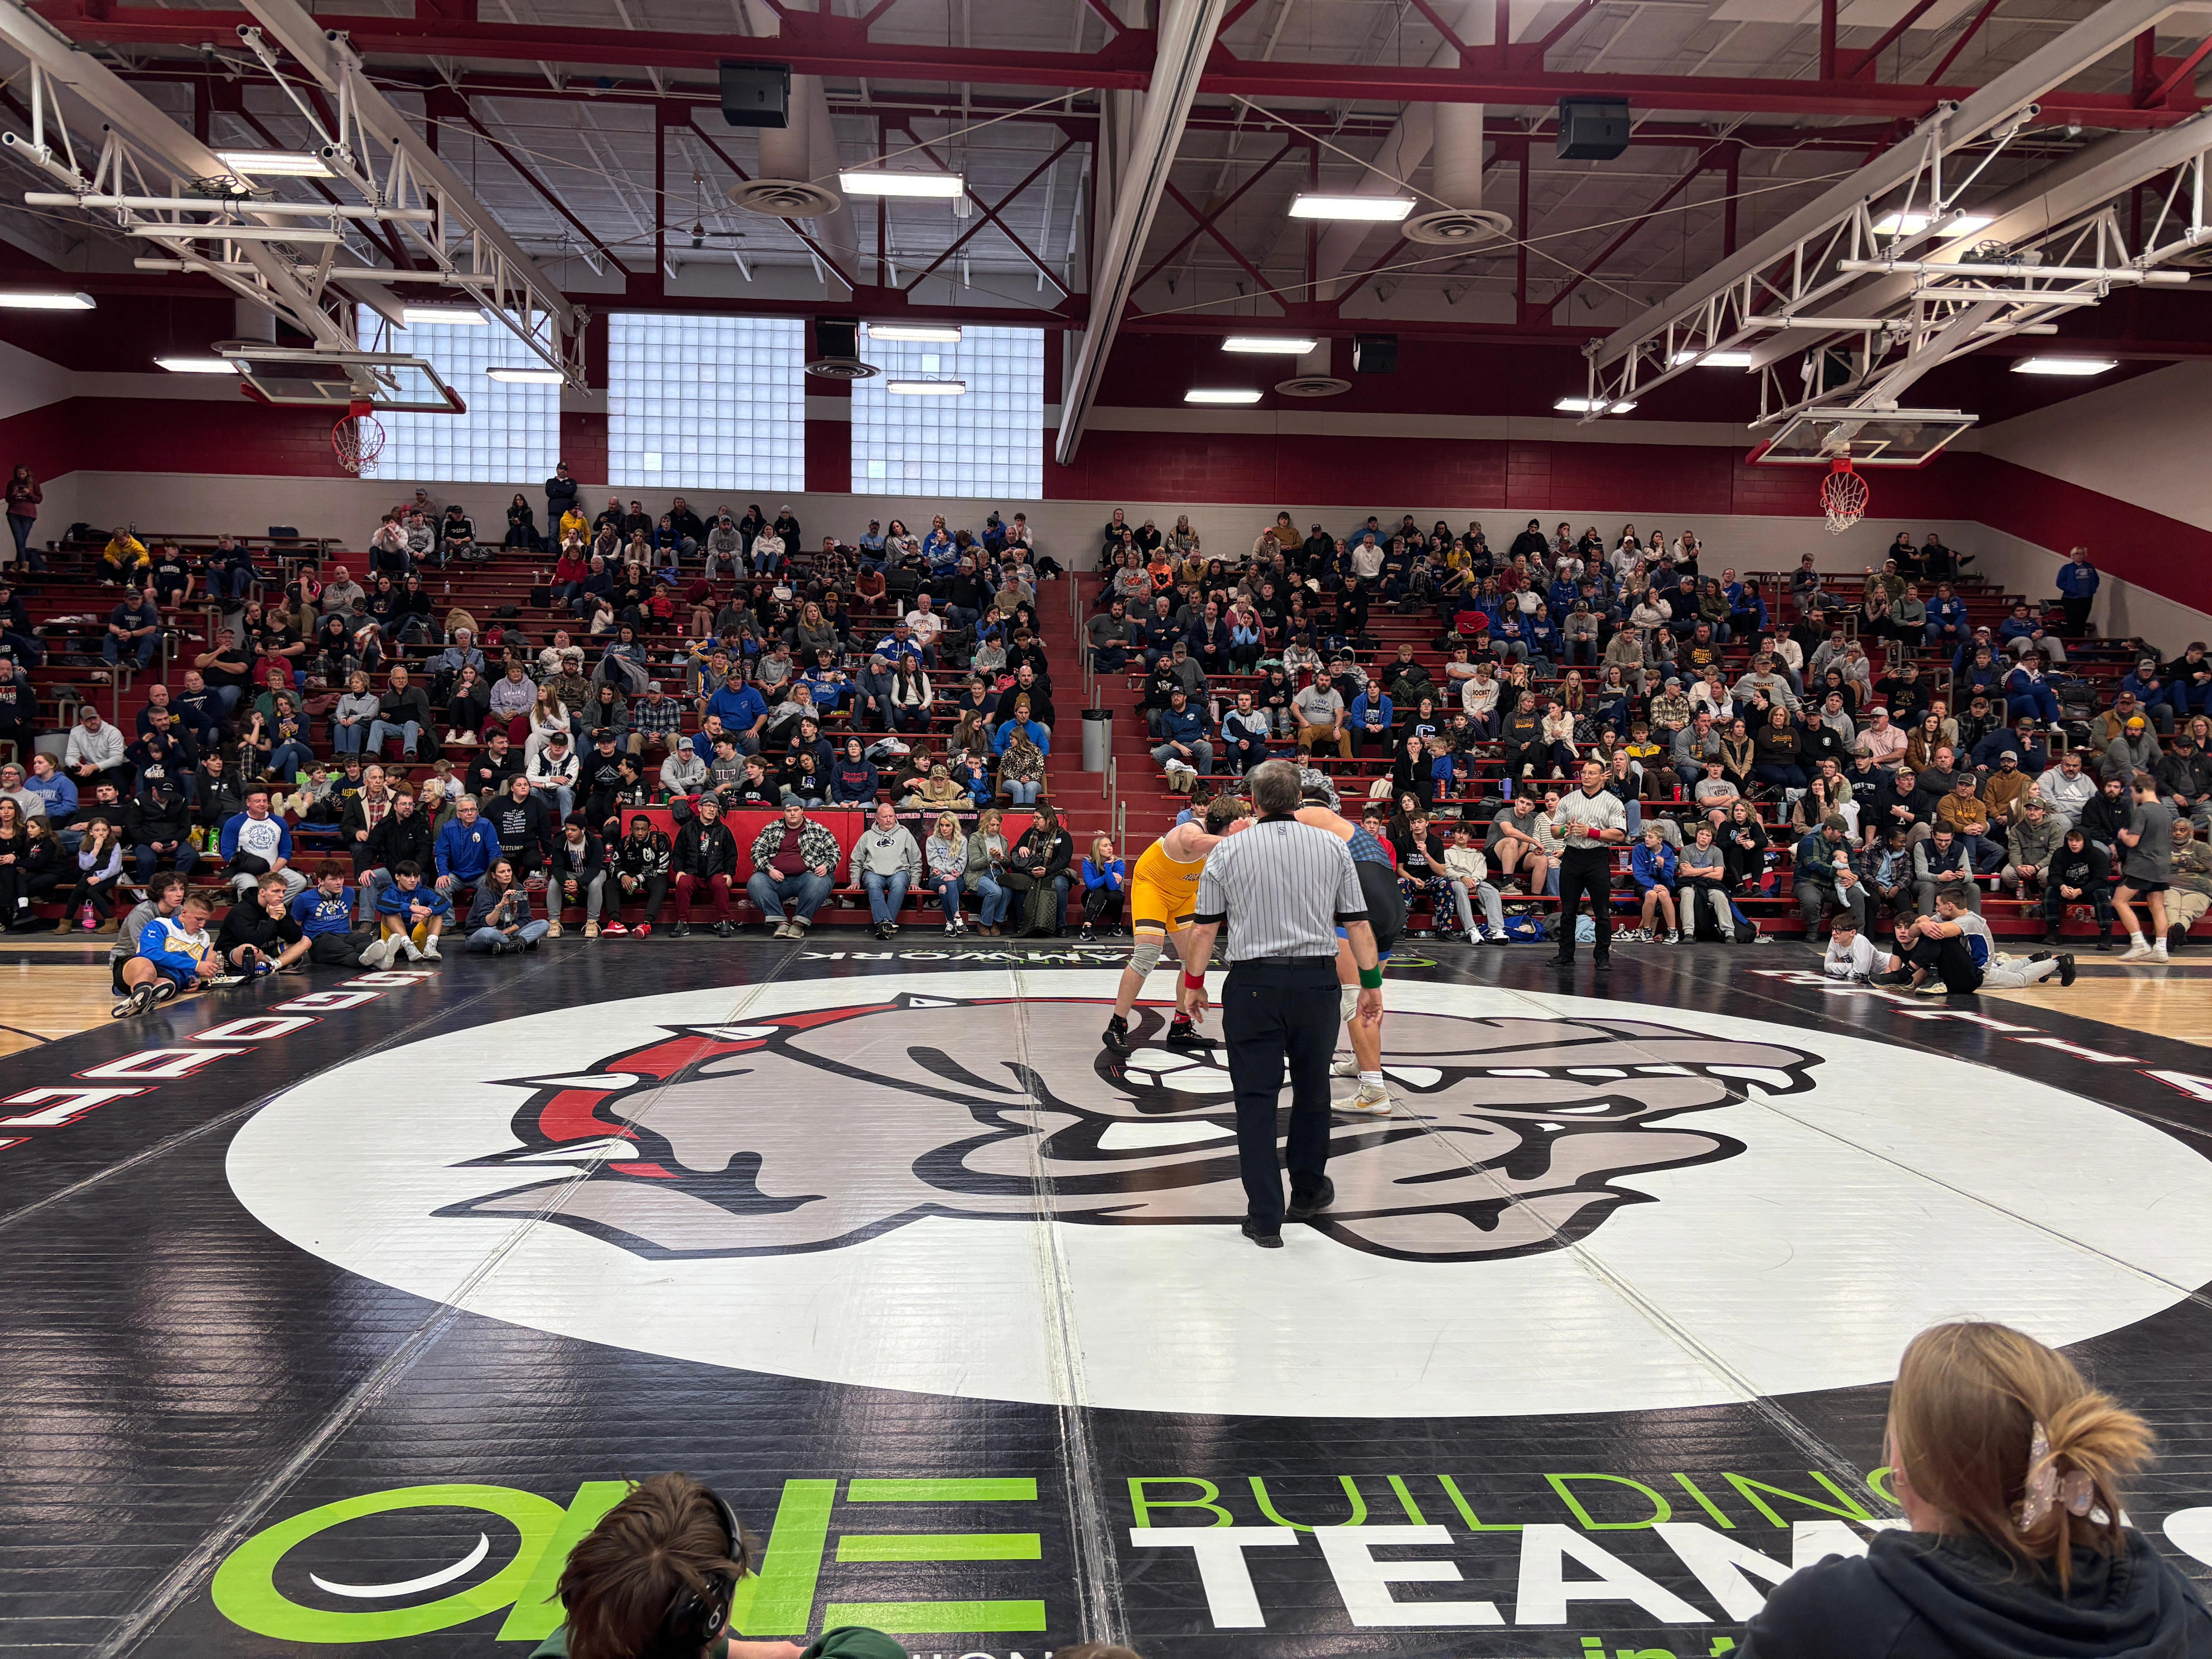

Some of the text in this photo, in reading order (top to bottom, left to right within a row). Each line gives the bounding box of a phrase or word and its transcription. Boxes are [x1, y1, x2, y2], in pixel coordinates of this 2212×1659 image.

[159, 565, 180, 574] WARREN
[1852, 782, 1864, 790] PENN
[247, 823, 268, 835] CAMBRIDGE
[248, 839, 273, 851] Wrestling
[797, 952, 1219, 962] AMWORK
[0, 970, 441, 1150] LDOGS
